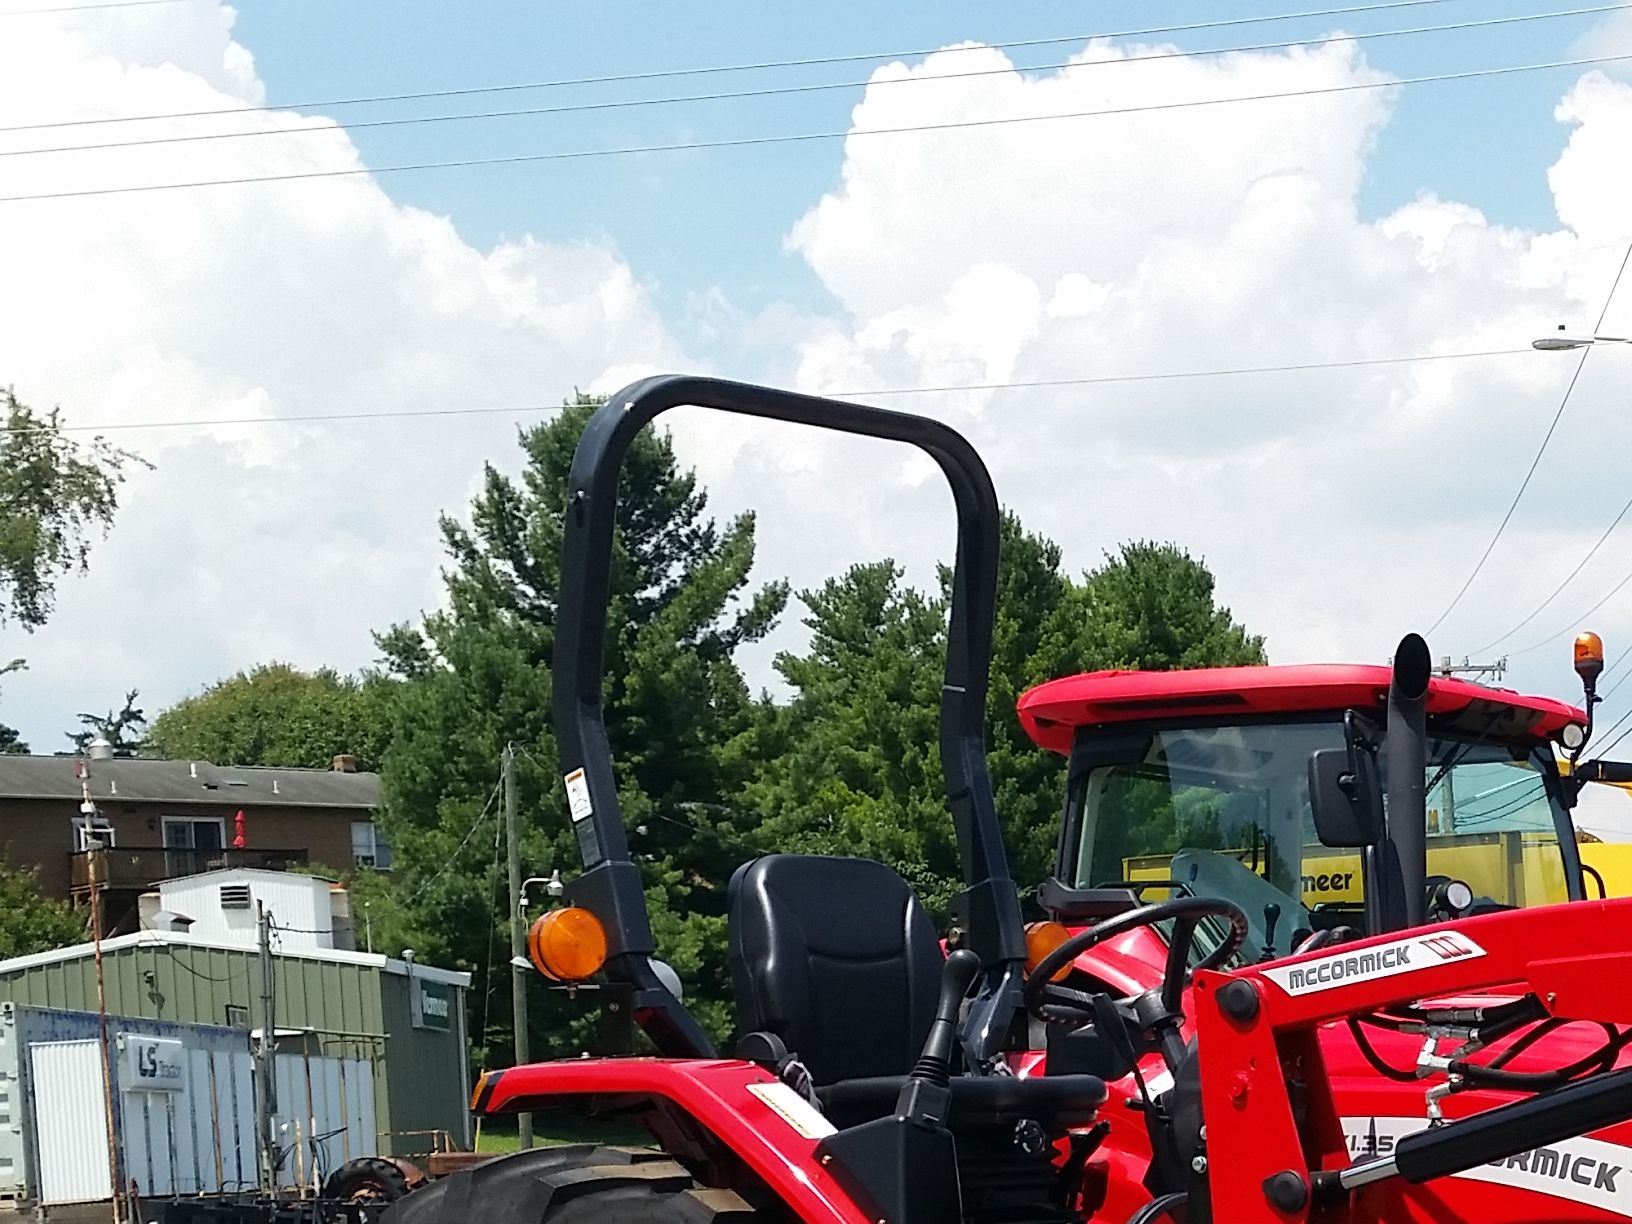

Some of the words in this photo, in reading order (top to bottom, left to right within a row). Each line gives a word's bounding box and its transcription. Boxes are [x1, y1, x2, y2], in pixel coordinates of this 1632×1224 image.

[139, 1045, 157, 1078] LS
[1344, 1134, 1394, 1152] 1.35
[1488, 1148, 1623, 1193] RMICK
